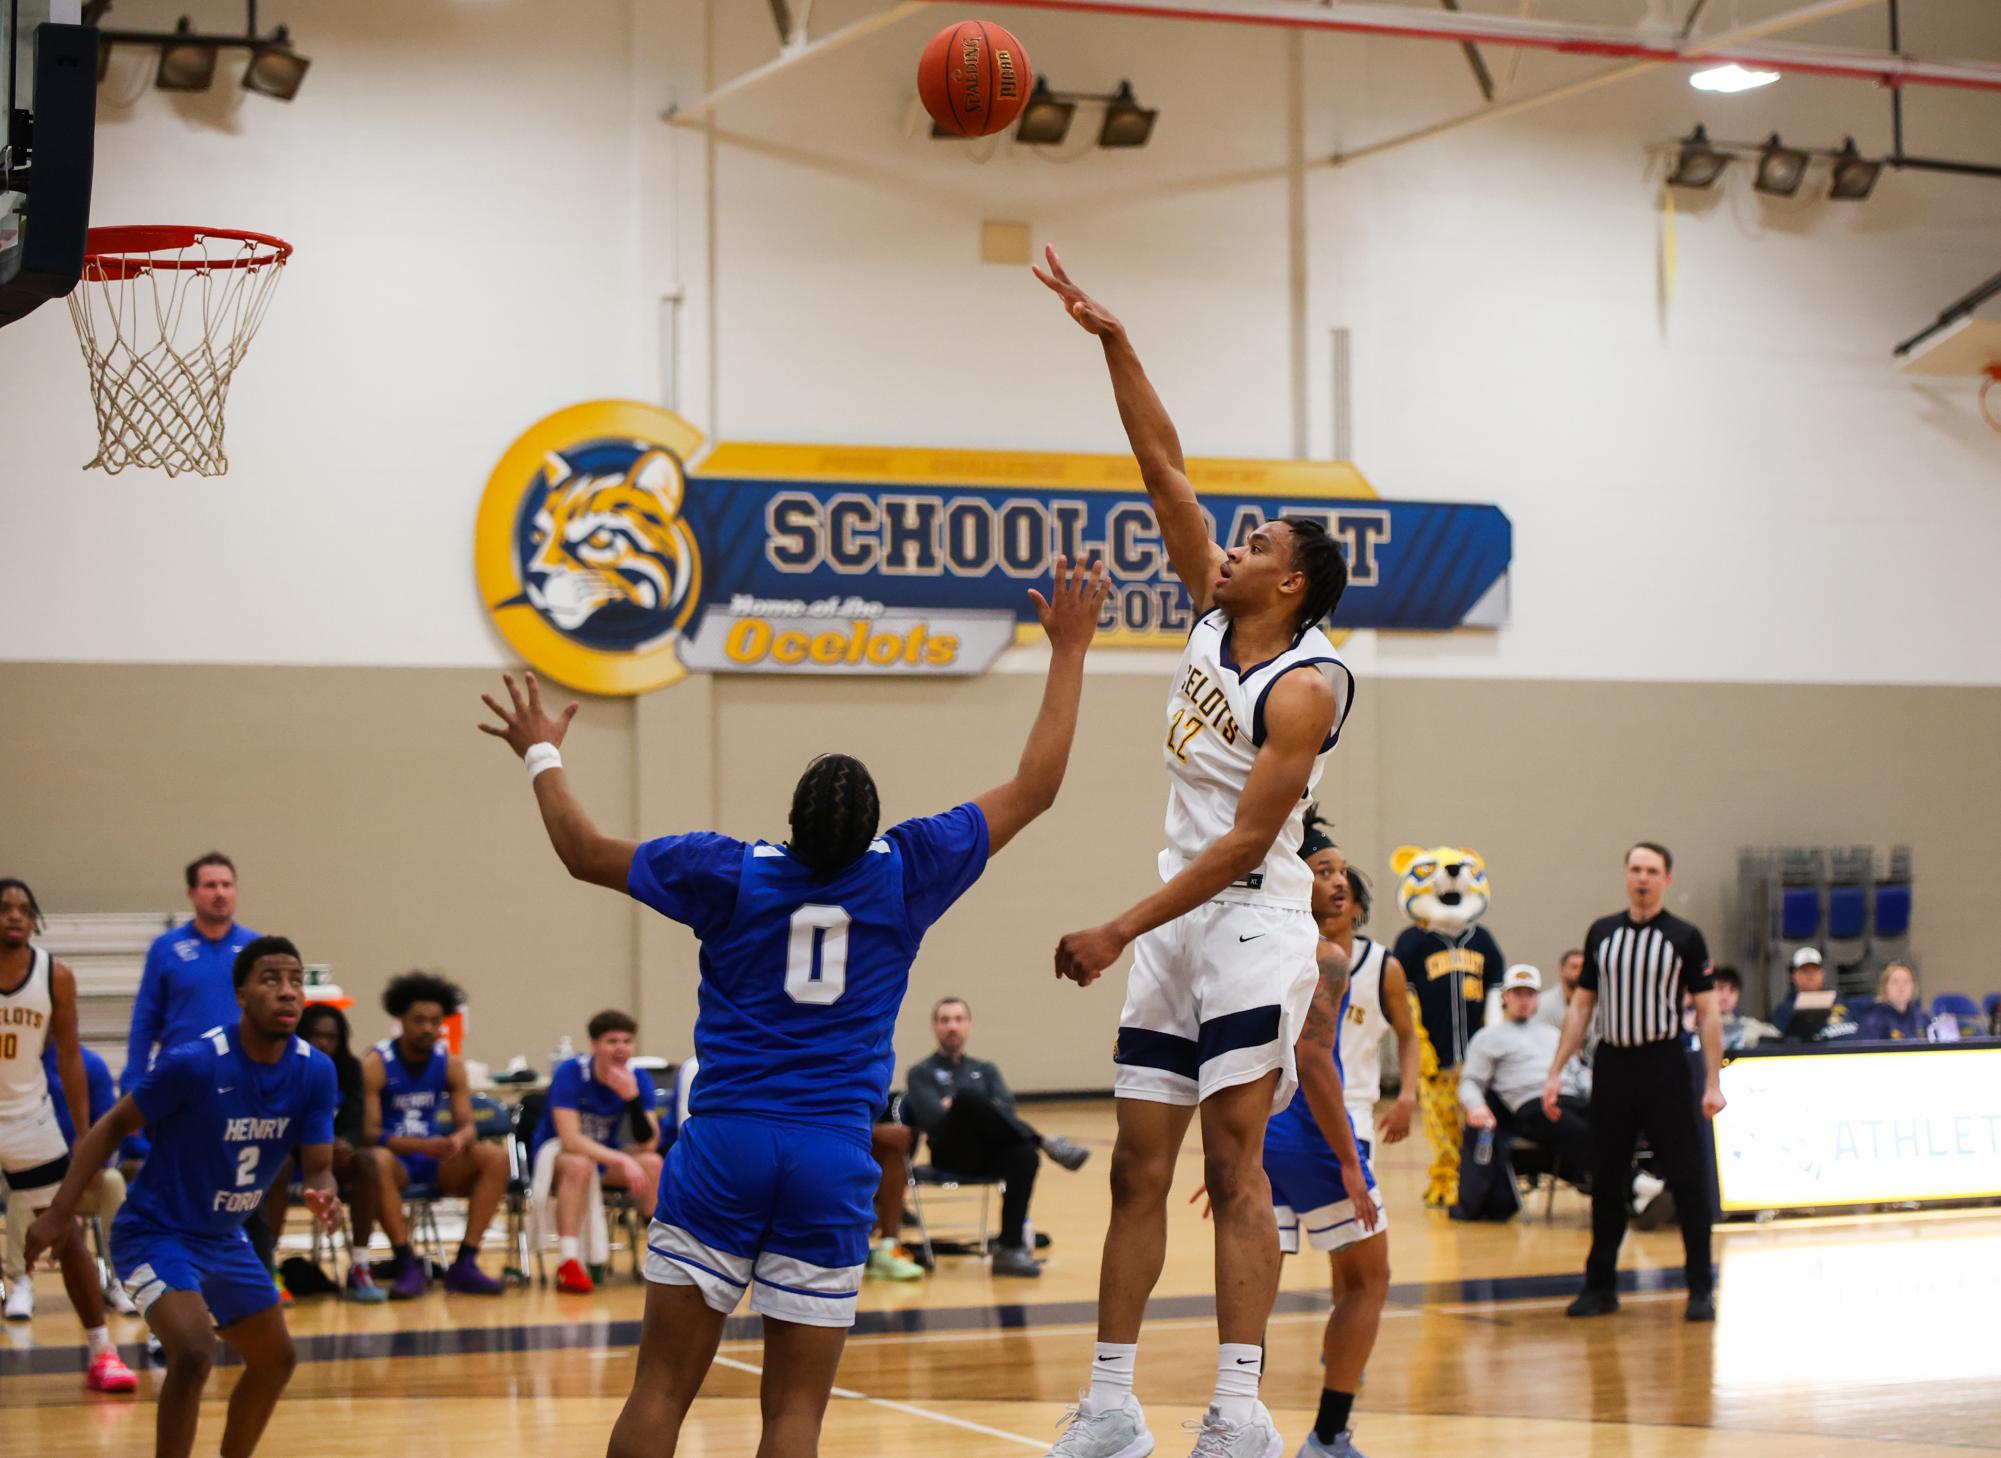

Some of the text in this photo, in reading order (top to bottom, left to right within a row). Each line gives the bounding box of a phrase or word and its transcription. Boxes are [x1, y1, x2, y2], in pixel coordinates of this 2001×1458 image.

[961, 36, 982, 113] SPALDING
[765, 491, 1391, 587] SCHOOLCT
[725, 617, 958, 665] Ocelots
[784, 903, 852, 1005] 0
[224, 1117, 291, 1141] HENRY
[235, 1145, 261, 1187] 2
[213, 1189, 263, 1213] FORD
